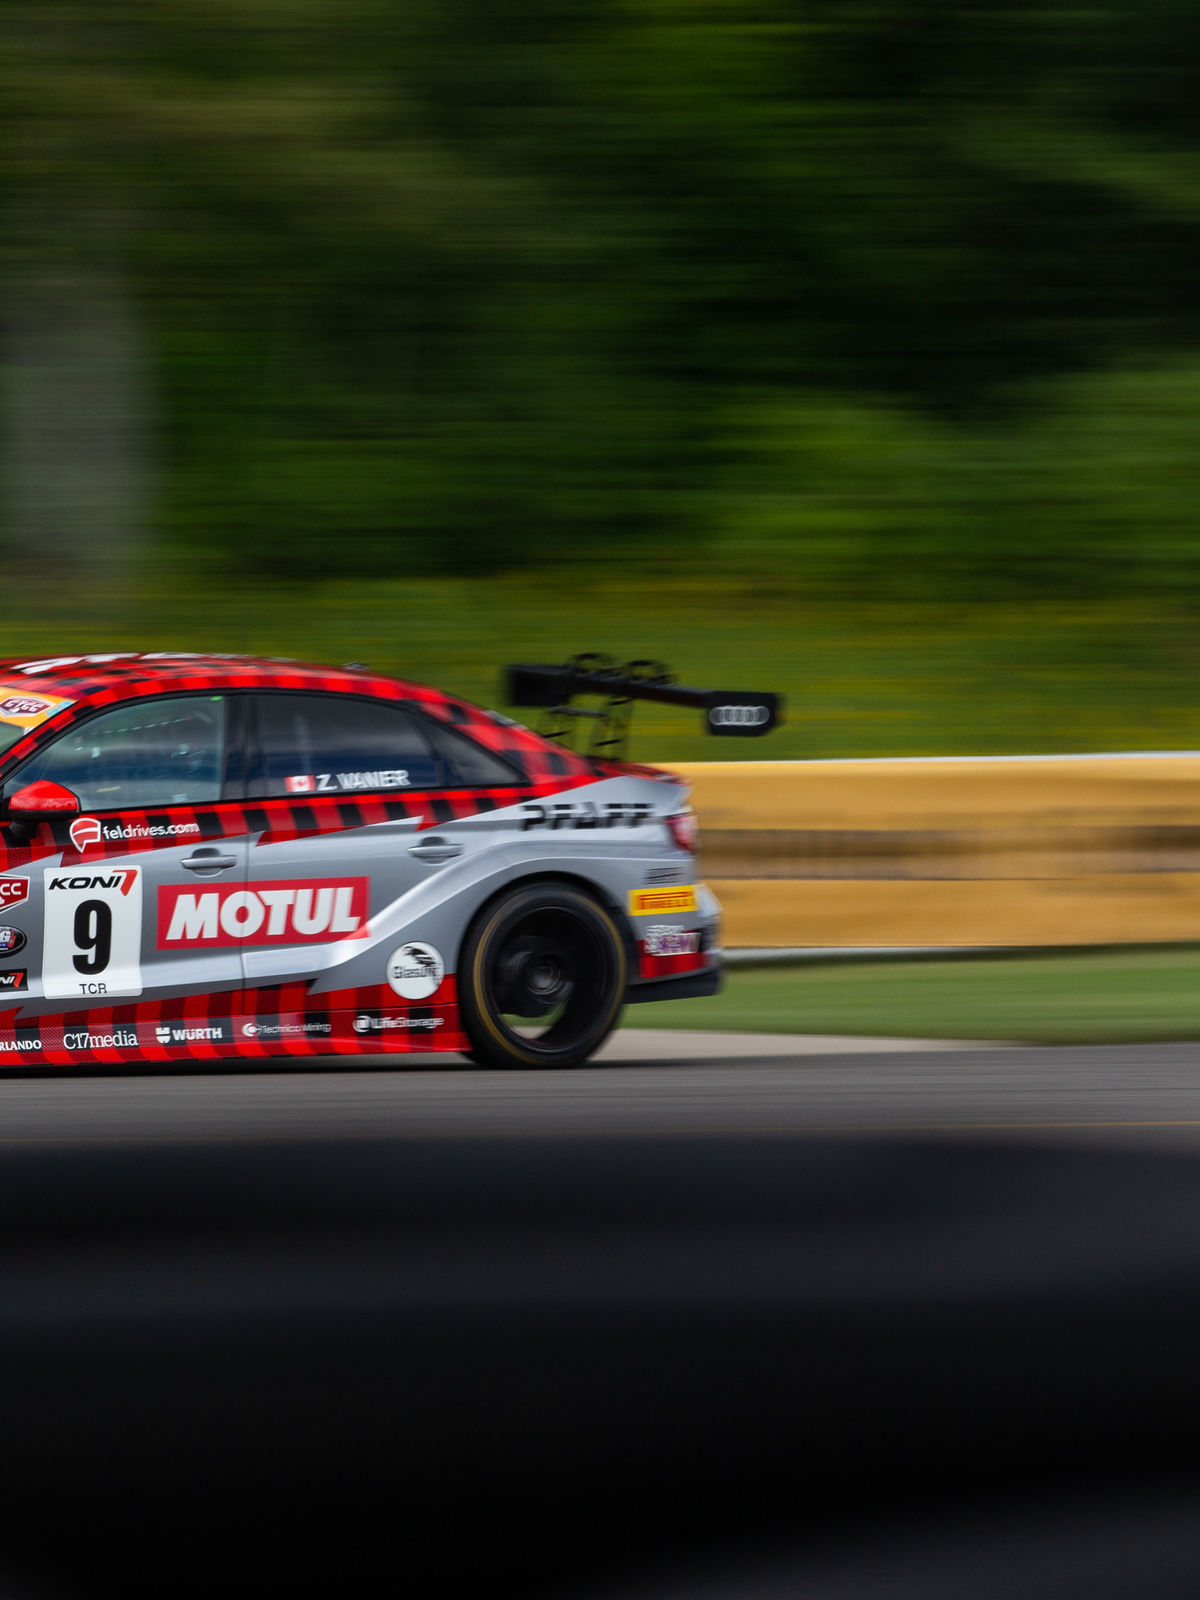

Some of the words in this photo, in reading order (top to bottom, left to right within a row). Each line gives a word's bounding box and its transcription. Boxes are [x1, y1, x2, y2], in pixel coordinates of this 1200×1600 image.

[522, 802, 655, 831] PFAFF
[102, 822, 201, 840] feldrives.com
[165, 886, 361, 941] MOTUL
[72, 899, 112, 976] 9
[79, 983, 107, 995] TCR
[63, 1030, 139, 1050] C17media
[172, 1027, 223, 1041] WÜRTH
